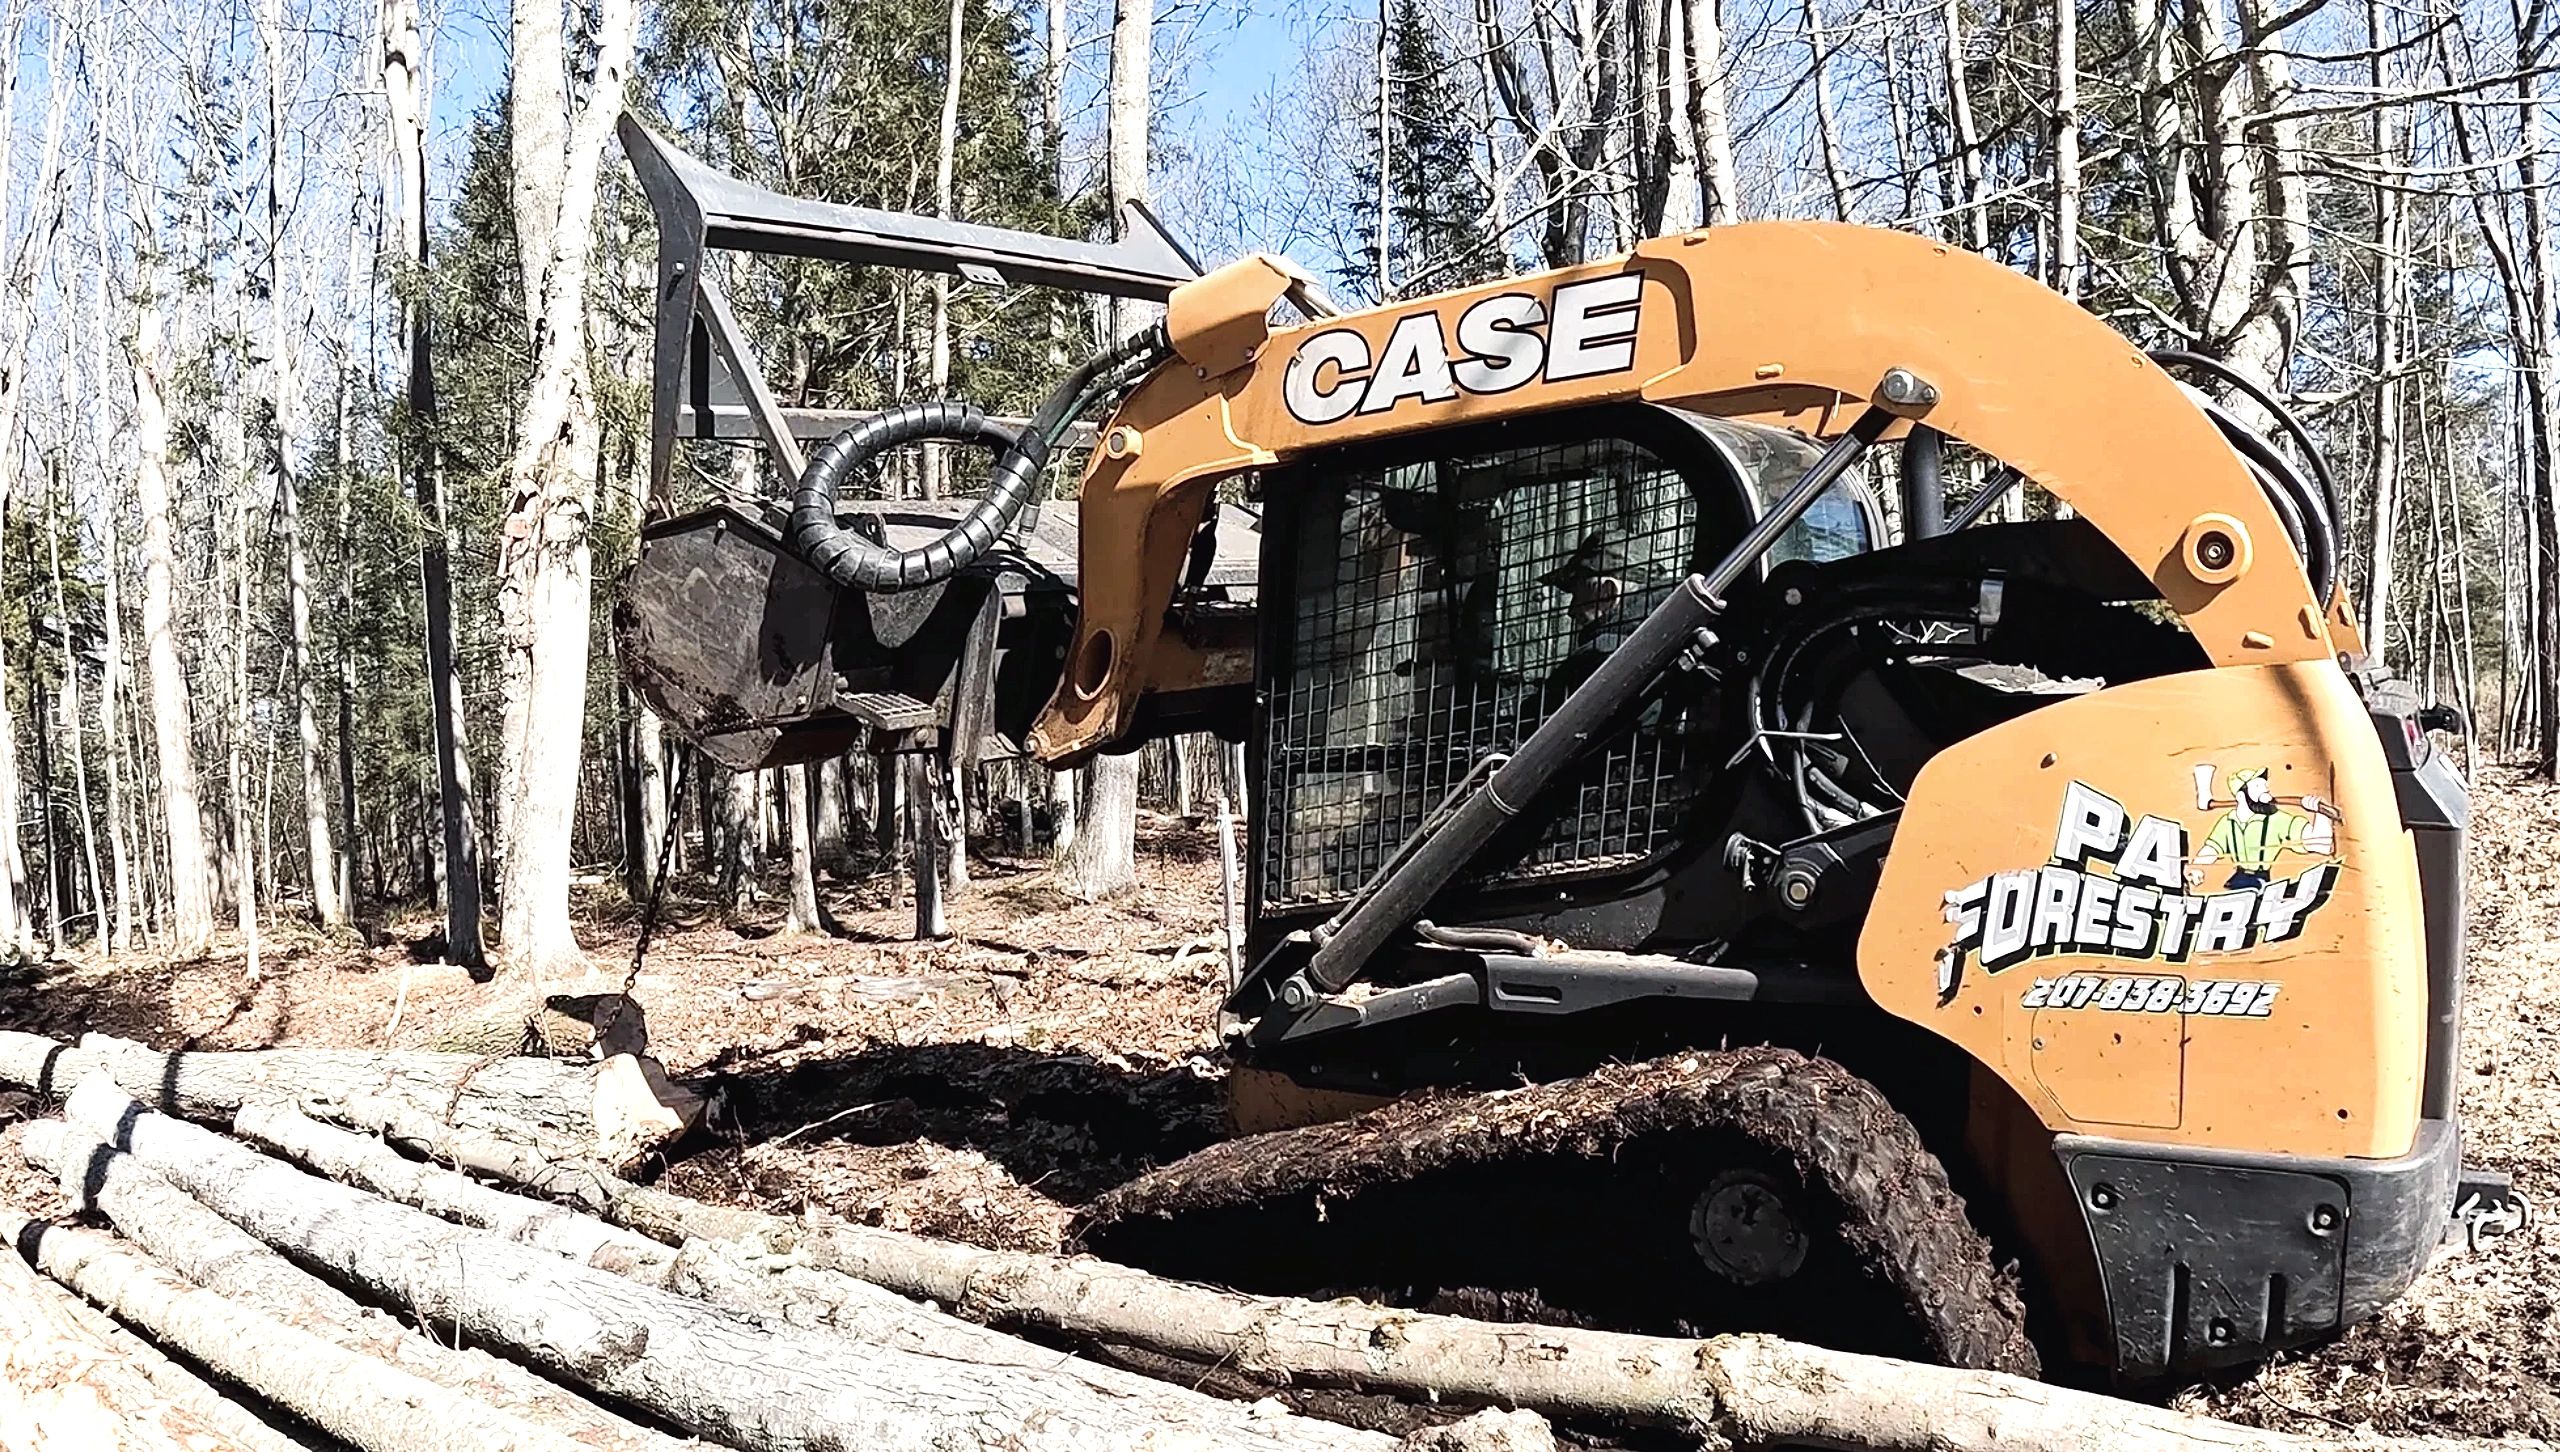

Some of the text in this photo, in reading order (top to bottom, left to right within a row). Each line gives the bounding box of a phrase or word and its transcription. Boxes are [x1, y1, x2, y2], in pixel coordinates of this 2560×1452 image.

[1284, 270, 1645, 424] CASE
[2054, 780, 2188, 888] PA
[1936, 860, 2342, 1008] FORESTRY
[2023, 975, 2280, 1016] 207-838-3692
